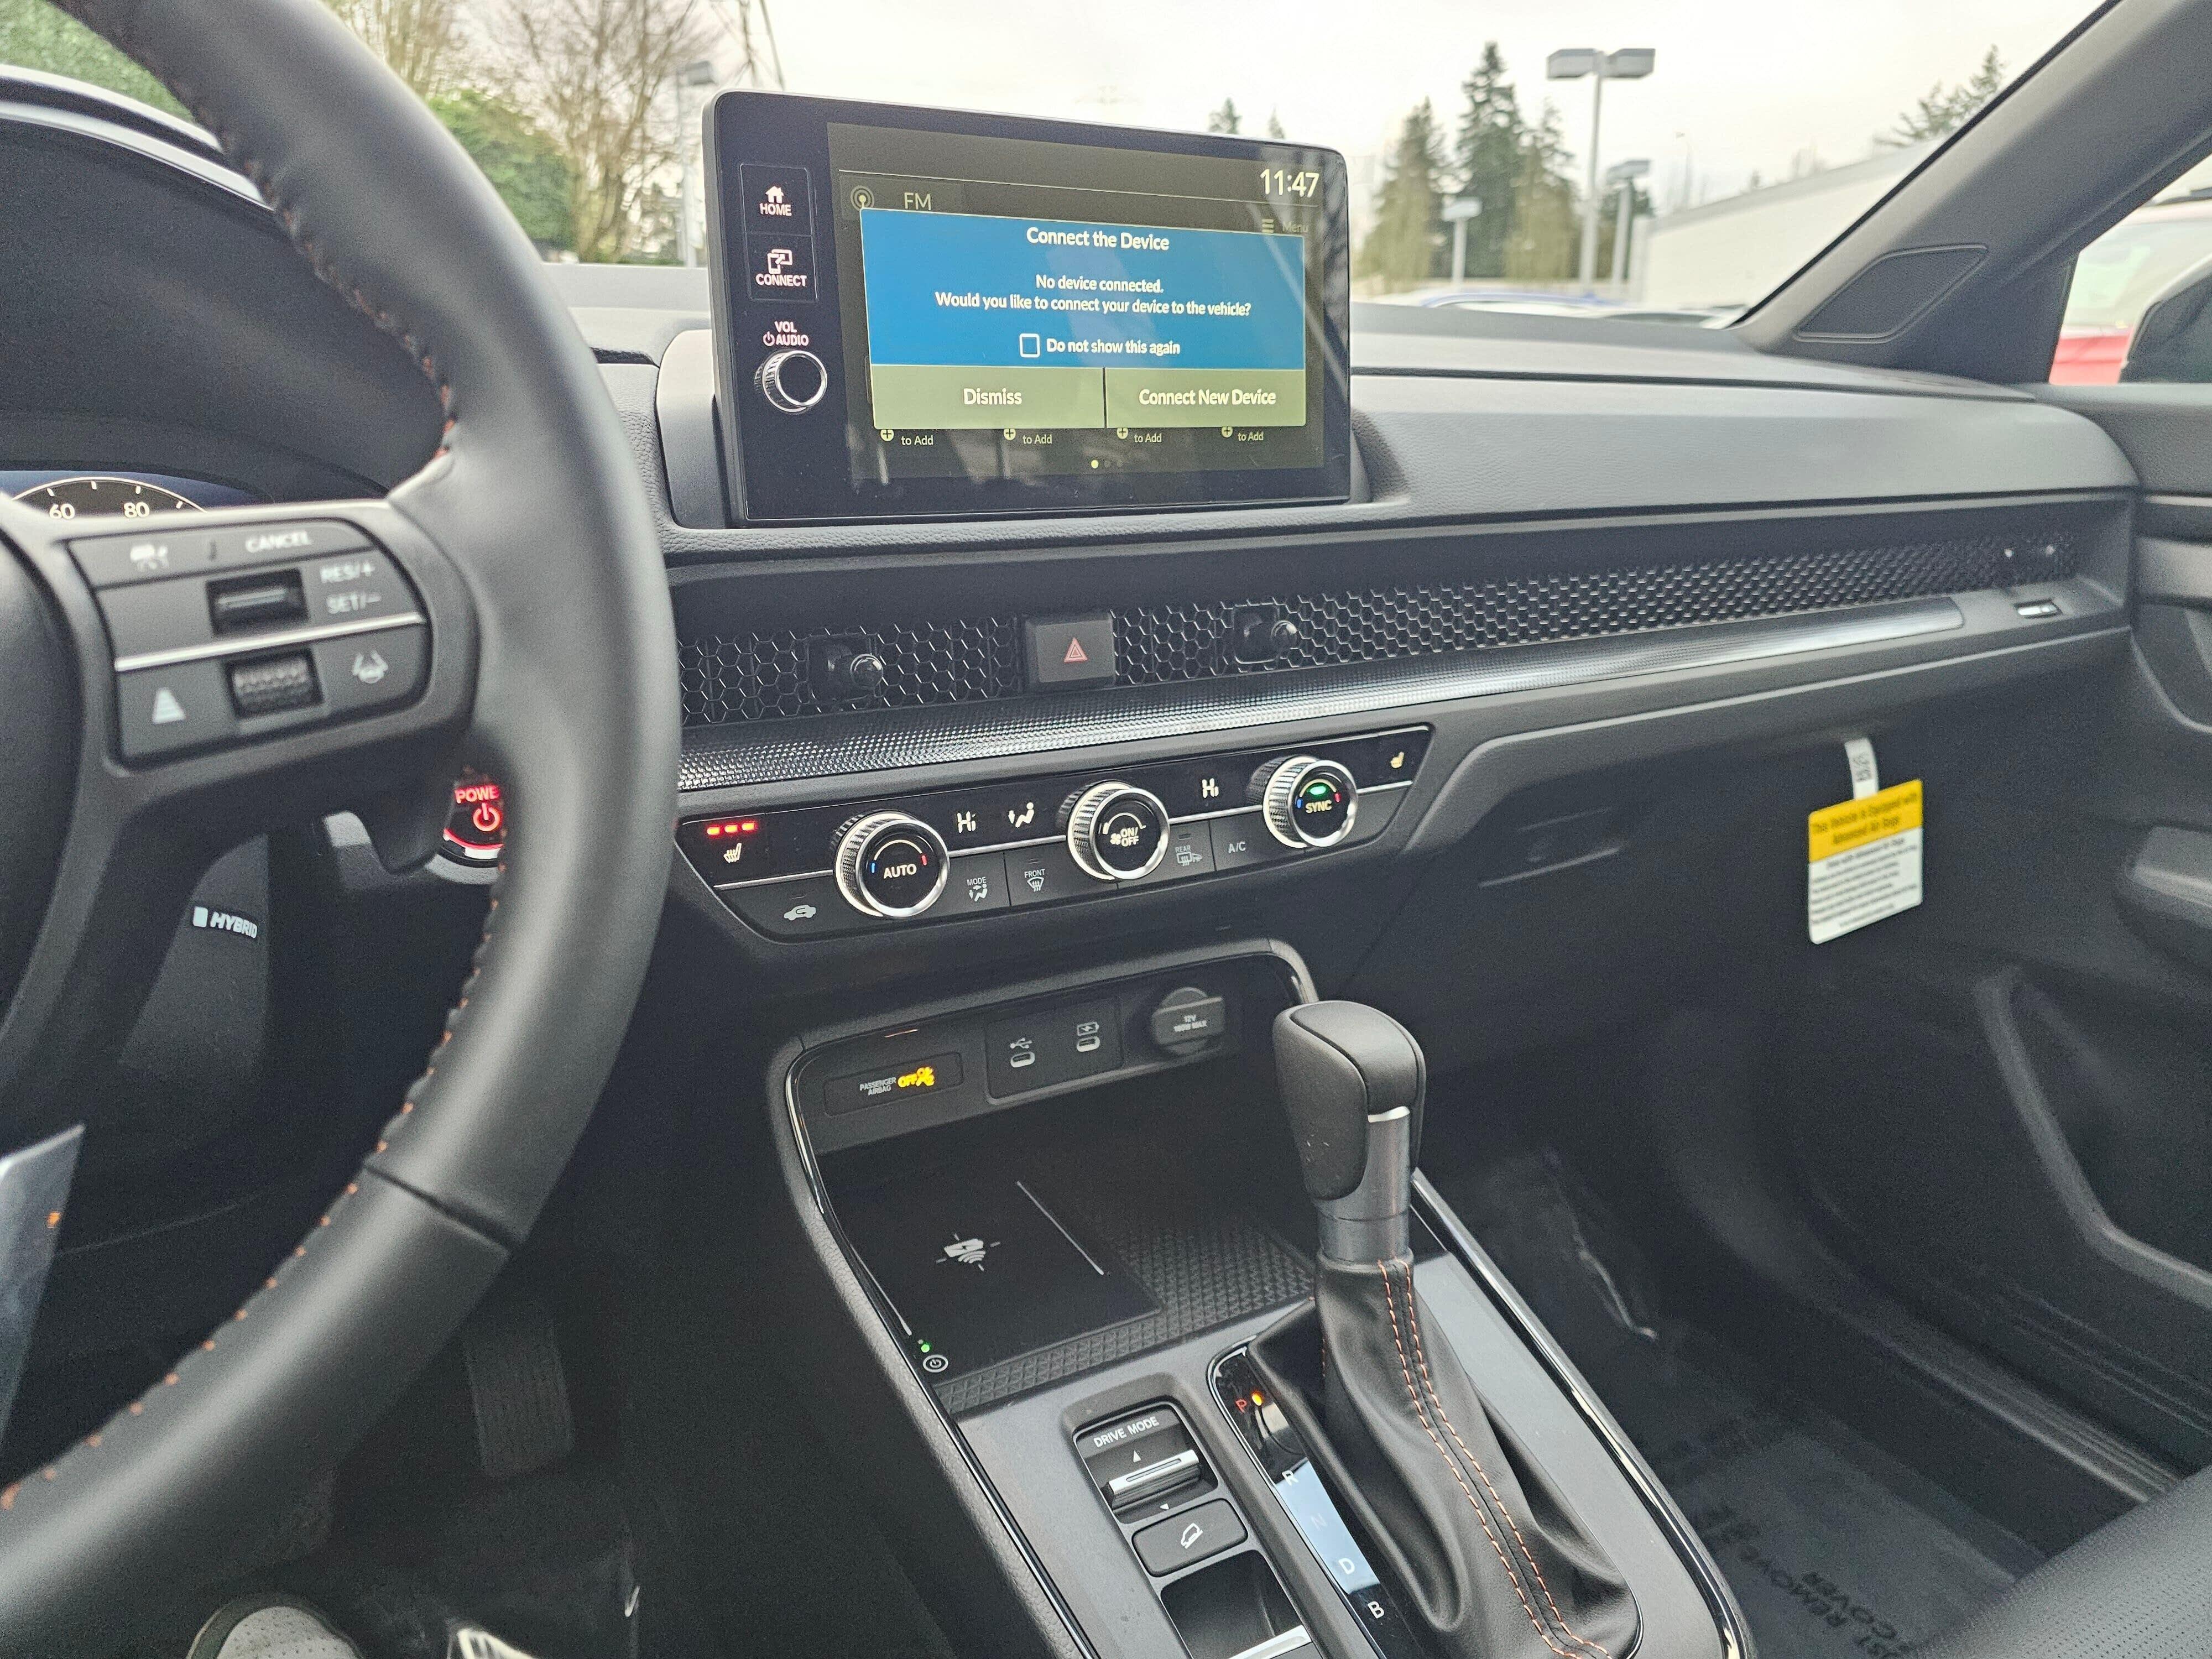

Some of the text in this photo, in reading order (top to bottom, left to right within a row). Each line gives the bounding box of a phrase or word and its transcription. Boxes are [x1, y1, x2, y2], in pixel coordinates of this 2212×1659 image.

[1260, 169, 1320, 197] 11:47
[904, 192, 932, 210] FM
[760, 203, 792, 217] HOME
[1282, 222, 1309, 233] Menu
[1026, 227, 1170, 250] Connect the Device
[755, 274, 807, 287] CONNECT
[1036, 274, 1164, 293] No device connected.
[935, 291, 1251, 316] Would you like to connect your device to the vehicle?
[775, 321, 797, 333] VOL
[776, 333, 809, 346] AUDIO
[1046, 338, 1181, 356] Do not show this again
[963, 388, 1022, 405] Dismiss
[1139, 389, 1276, 405] Connect New Device
[901, 435, 934, 446] to Add
[1022, 434, 1052, 445] to Add
[1134, 432, 1162, 443] to Add
[1238, 431, 1264, 442] to Add
[49, 503, 75, 519] 60
[123, 502, 150, 518] 80
[245, 531, 312, 553] CANCEL
[455, 786, 500, 804] POWE
[1306, 800, 1332, 813] SYNC
[1121, 836, 1139, 847] OFF
[1228, 841, 1246, 853] A/C
[883, 863, 917, 879] AUTO
[1024, 868, 1045, 879] FRONT
[967, 876, 987, 886] MODE
[210, 911, 258, 939] HYBRID
[860, 1077, 896, 1091] PASSENGER
[898, 1073, 918, 1088] OFF
[868, 1084, 891, 1096] AIRBAG
[1235, 1398, 1248, 1413] P
[1093, 1416, 1160, 1448] DRIVE MODE
[1281, 1470, 1299, 1486] R
[1338, 1557, 1355, 1575] D
[1366, 1600, 1385, 1619] B
